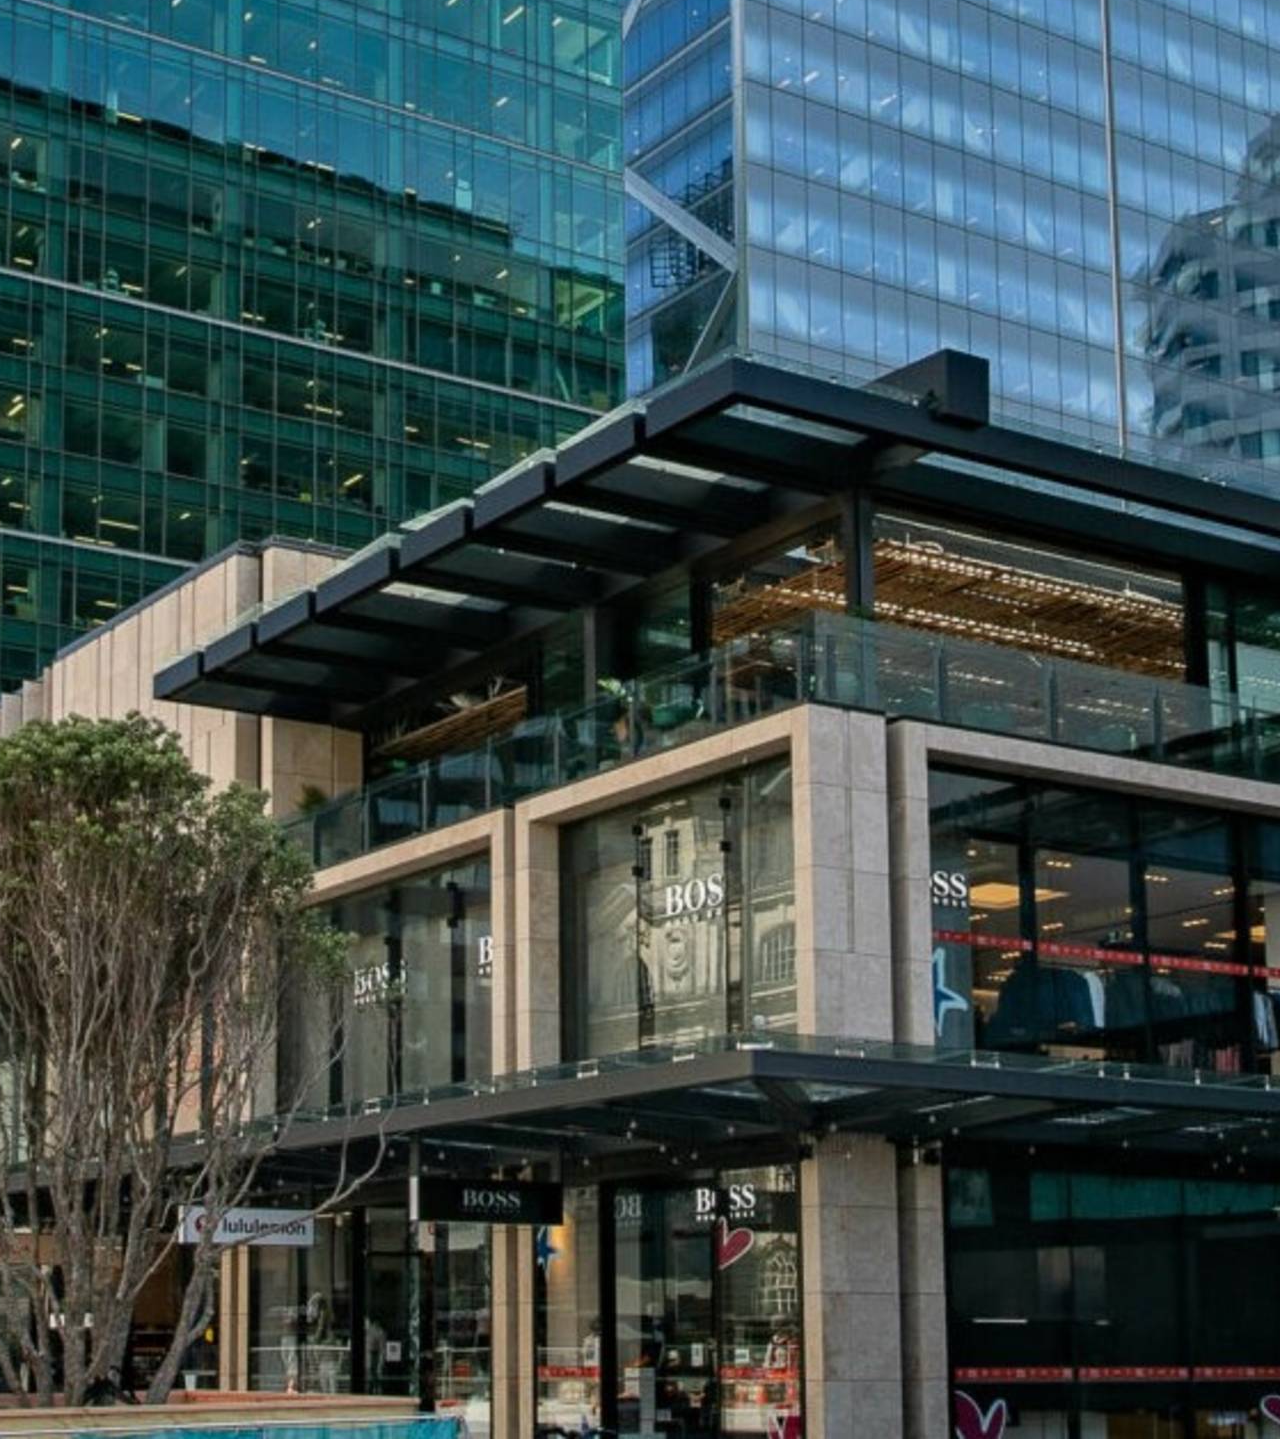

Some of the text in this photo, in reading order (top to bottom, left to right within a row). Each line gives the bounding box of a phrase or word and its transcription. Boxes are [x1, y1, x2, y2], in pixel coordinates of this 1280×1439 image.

[929, 870, 967, 899] SS
[463, 1188, 521, 1208] BOSS
[696, 1183, 756, 1213] BSS
